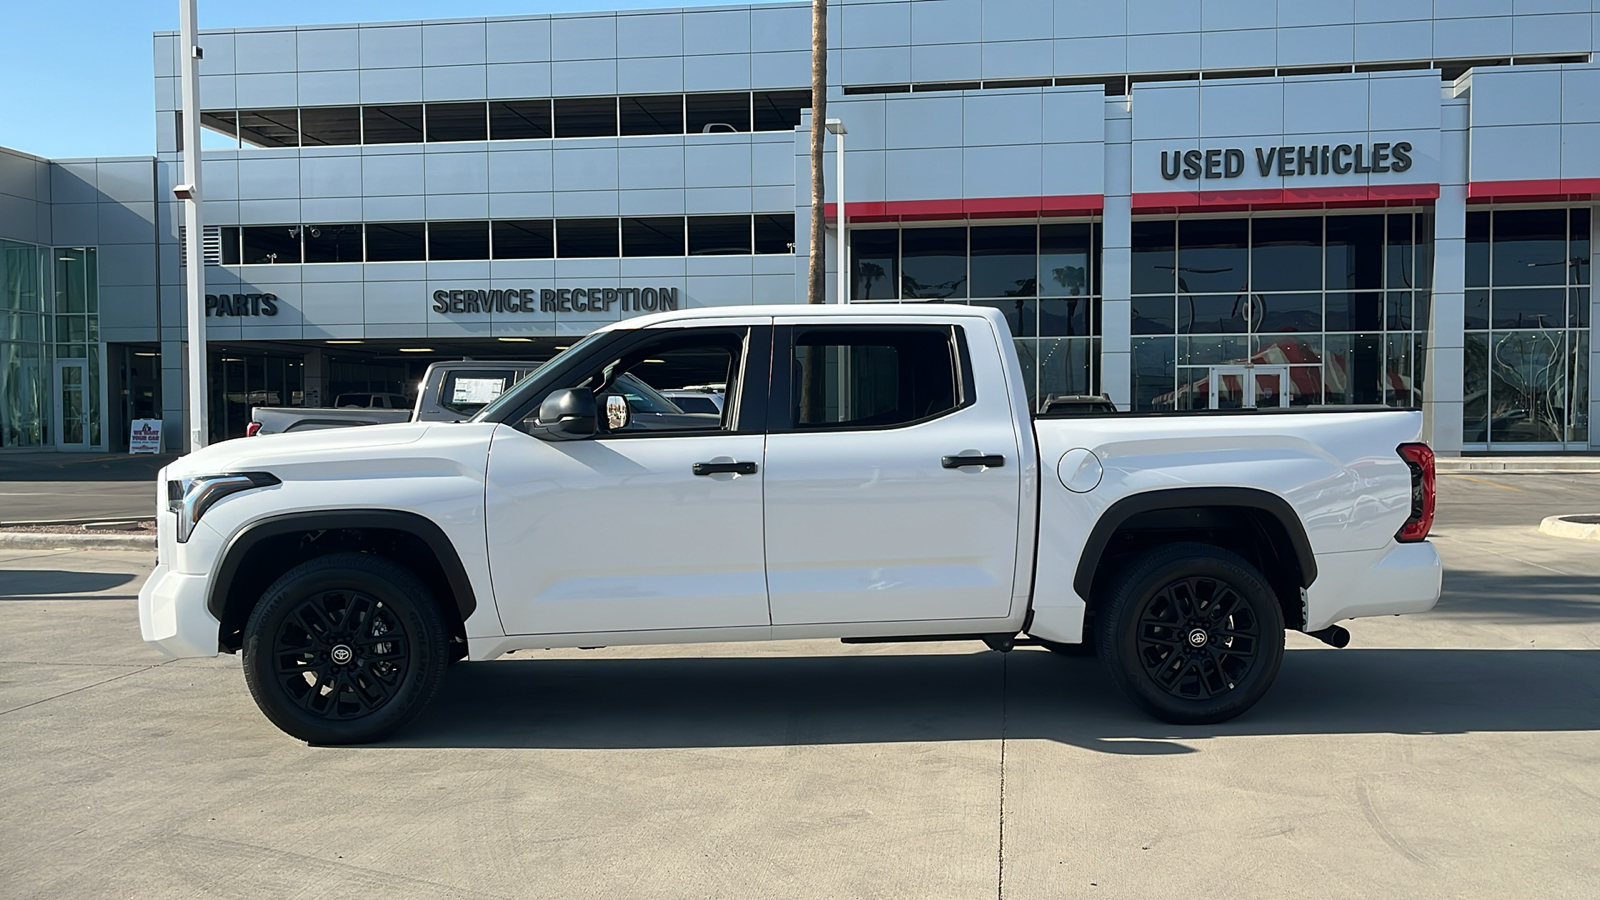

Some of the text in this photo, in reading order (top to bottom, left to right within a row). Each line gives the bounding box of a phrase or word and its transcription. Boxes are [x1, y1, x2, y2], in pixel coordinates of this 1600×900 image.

[1160, 142, 1413, 180] USED VEHICLES
[206, 293, 278, 316] PARTS
[433, 288, 678, 313] SERVICE RECEPTION
